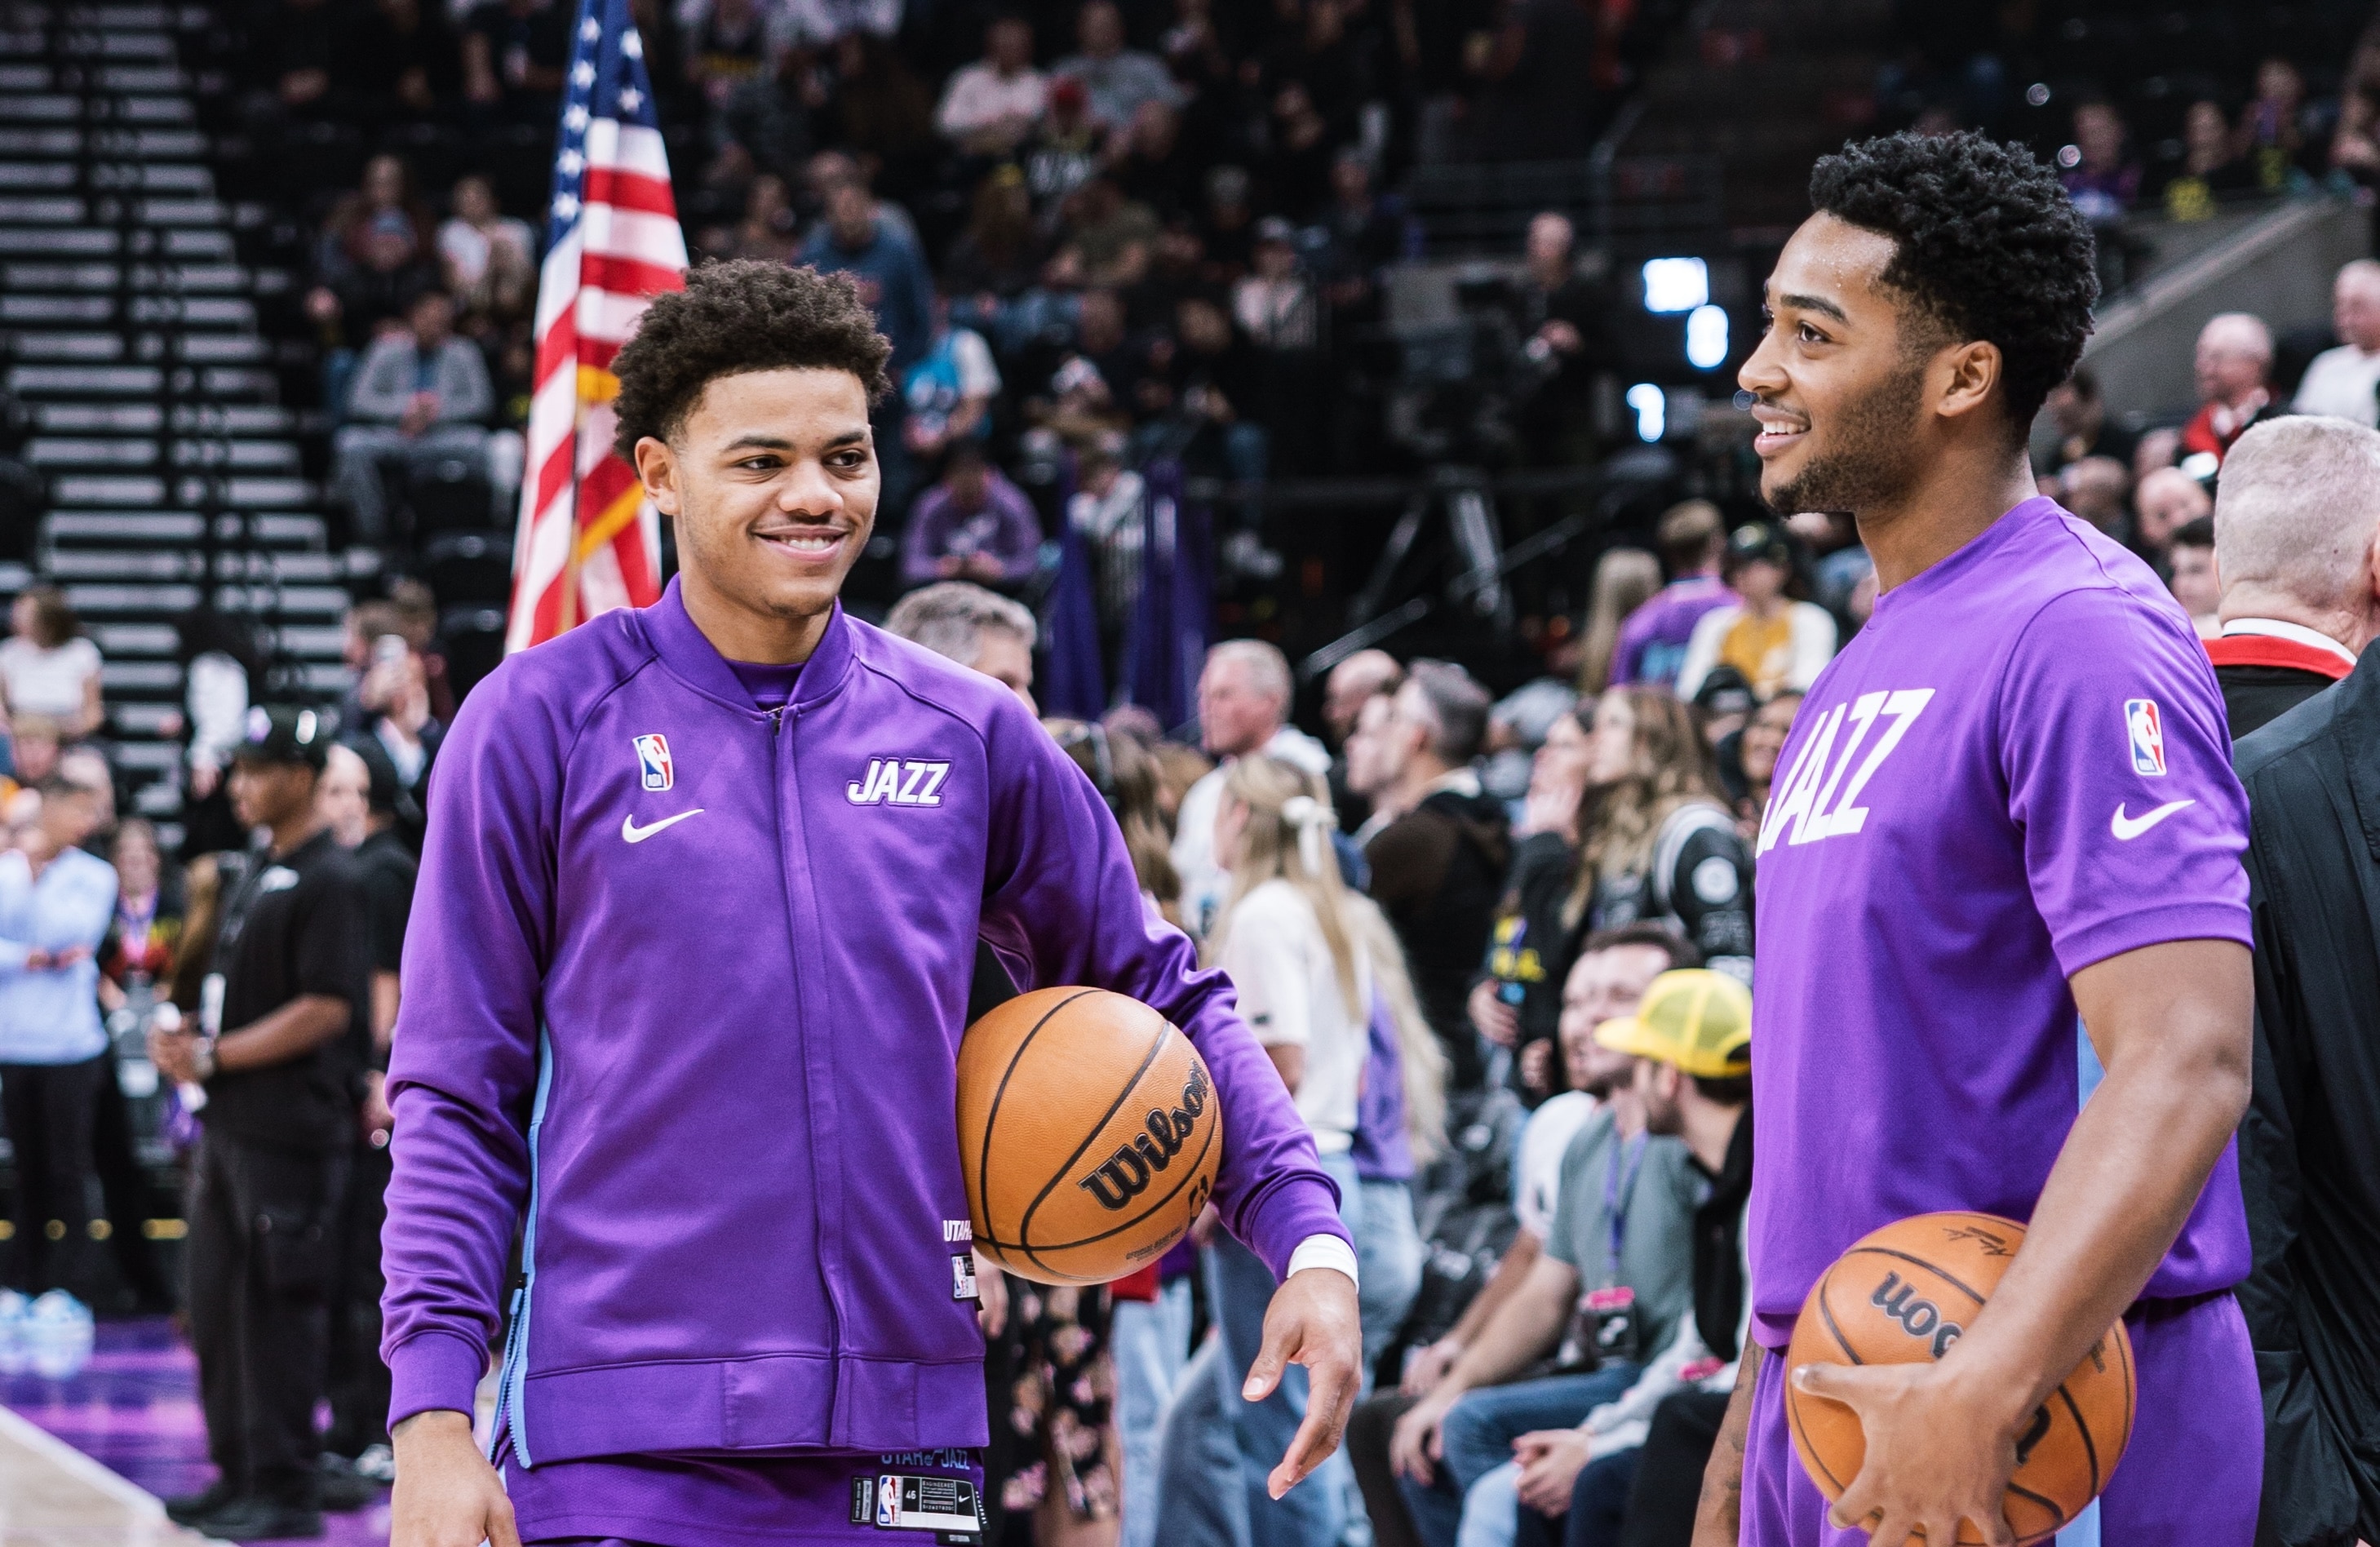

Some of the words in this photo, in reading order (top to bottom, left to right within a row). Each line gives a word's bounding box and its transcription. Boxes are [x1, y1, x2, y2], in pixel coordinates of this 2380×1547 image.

[848, 759, 950, 805] JAZZ
[1755, 688, 1936, 859] JAZZ
[1077, 1058, 1209, 1211] Wilson
[905, 1490, 917, 1500] 46
